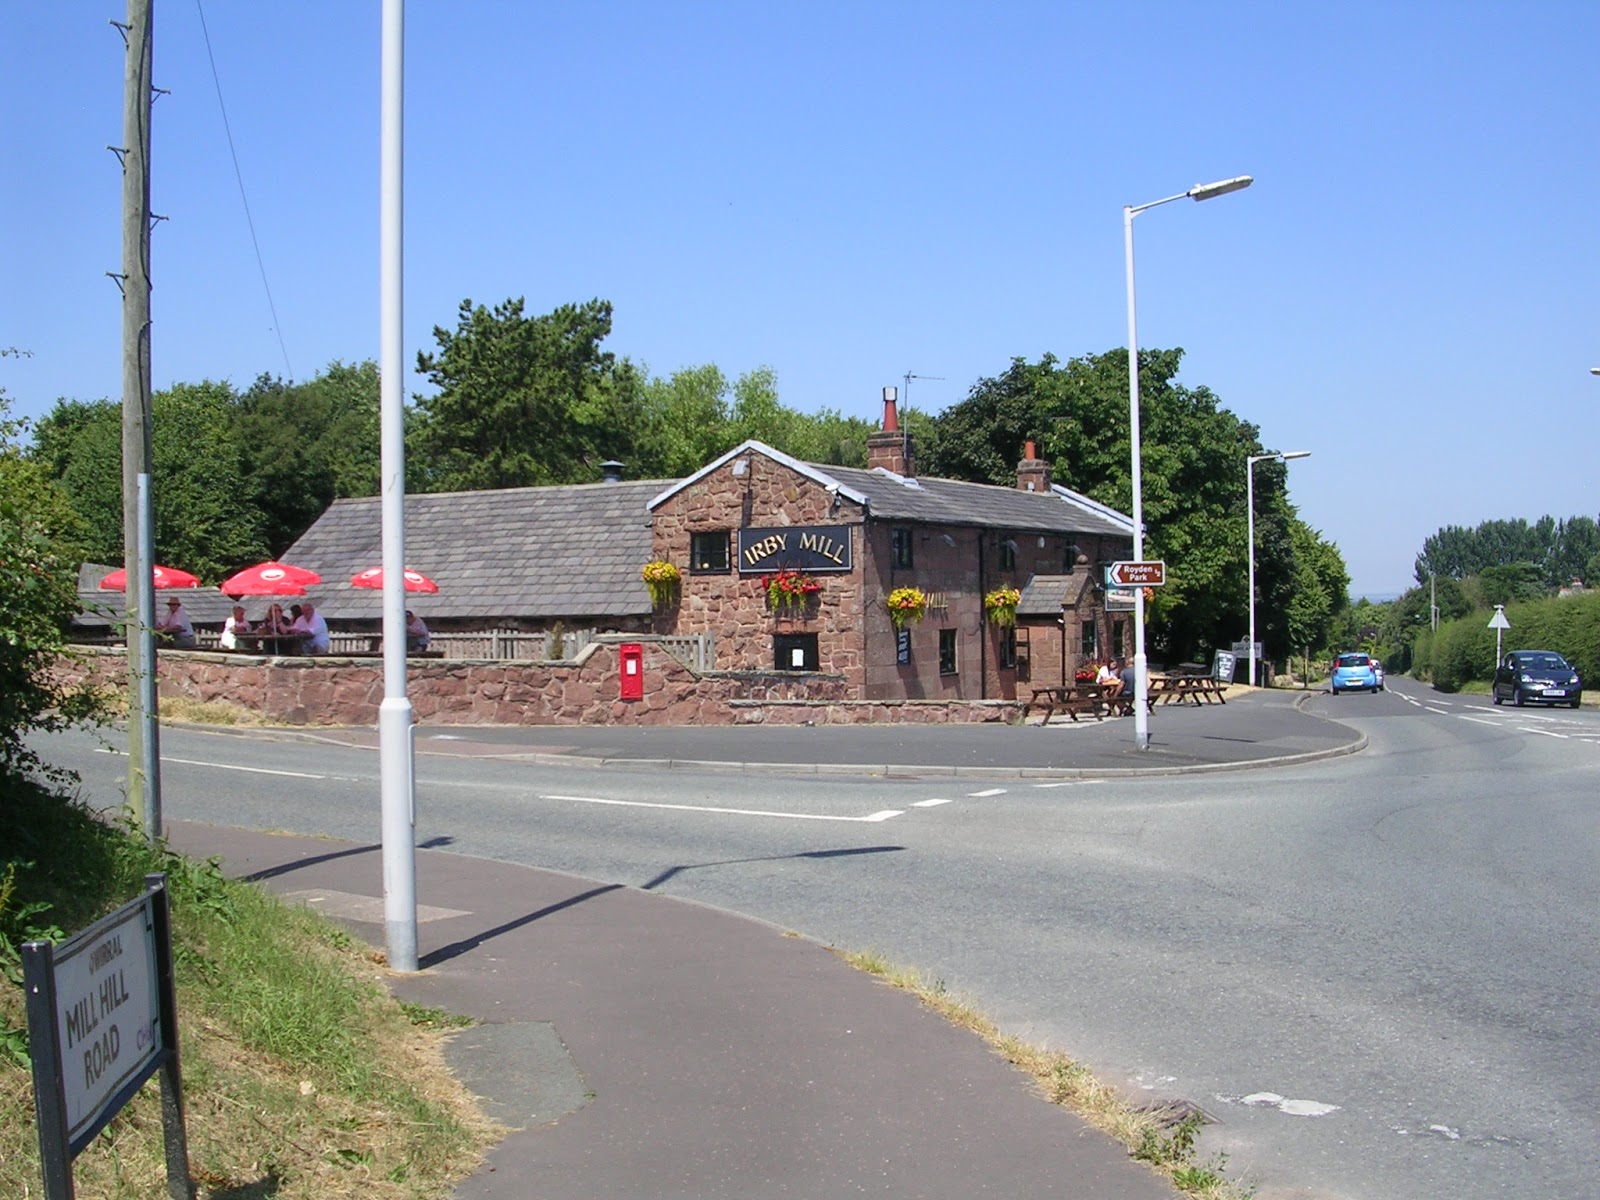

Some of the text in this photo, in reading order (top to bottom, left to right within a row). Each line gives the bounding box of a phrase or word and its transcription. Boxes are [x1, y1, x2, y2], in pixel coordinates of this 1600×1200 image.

[744, 532, 845, 565] IRBY MILL
[1123, 565, 1153, 574] Royden
[1129, 573, 1148, 581] Park
[66, 991, 99, 1050] MILL
[99, 968, 130, 1020] HILL
[84, 1024, 120, 1090] ROAD
